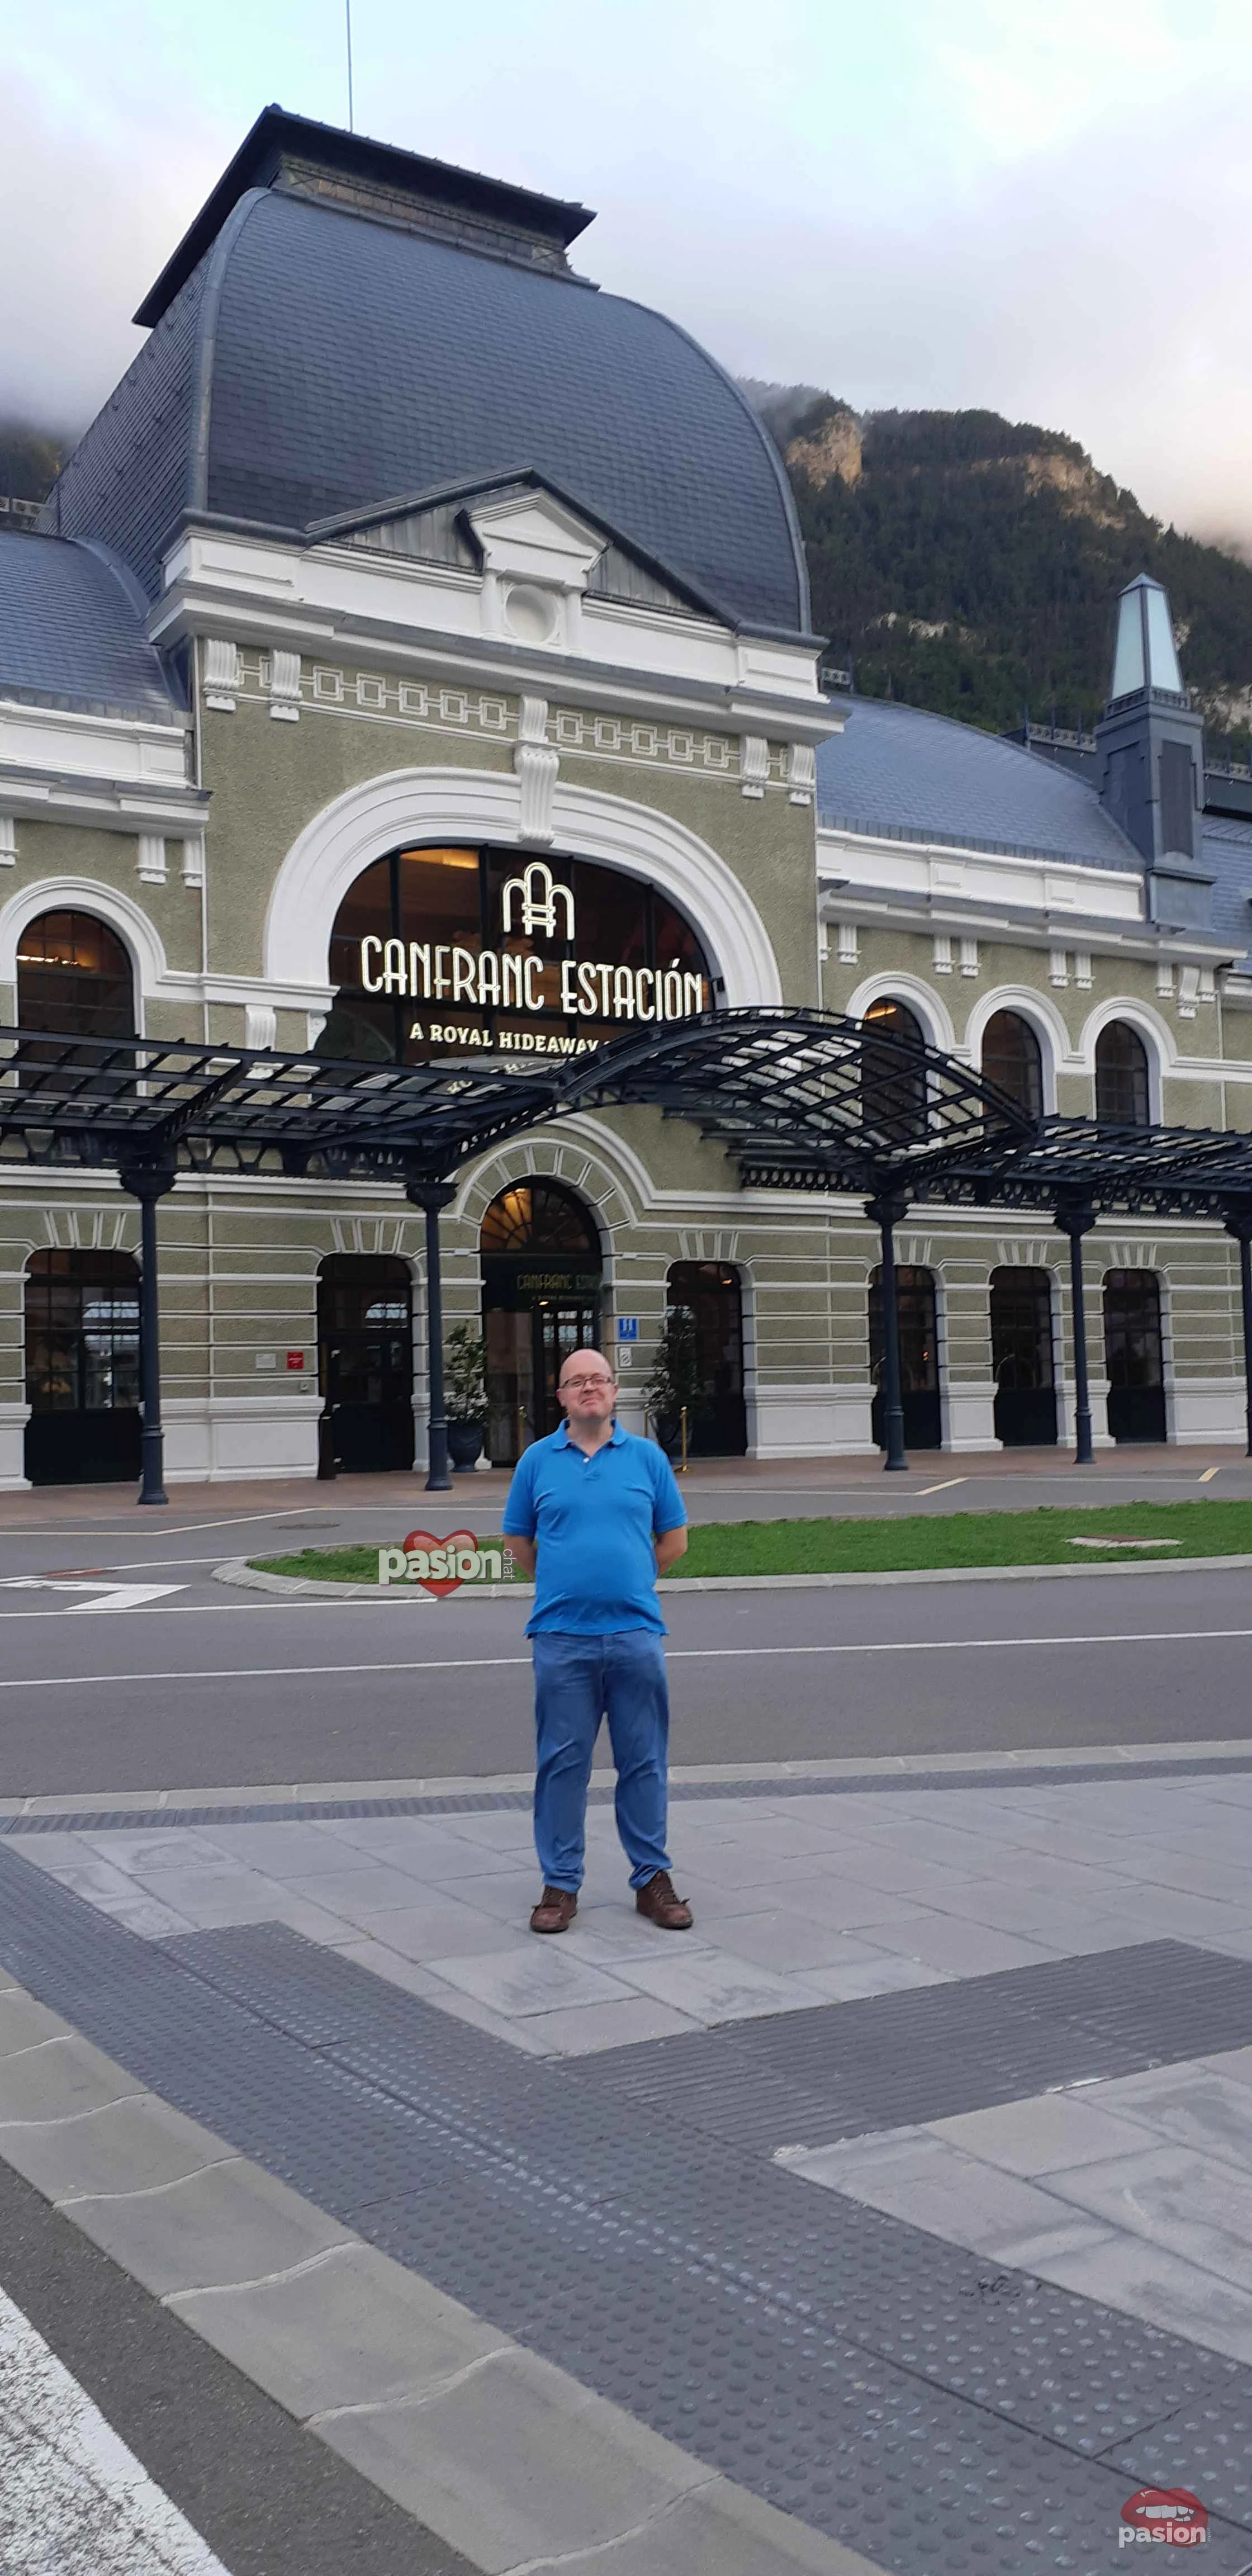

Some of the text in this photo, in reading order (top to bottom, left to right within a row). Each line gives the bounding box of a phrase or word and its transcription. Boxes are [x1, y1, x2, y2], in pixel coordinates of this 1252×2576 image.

[361, 935, 703, 1021] CANFRANC ESTACIÓN
[409, 1022, 599, 1054] A ROYAL HIDEAWAY
